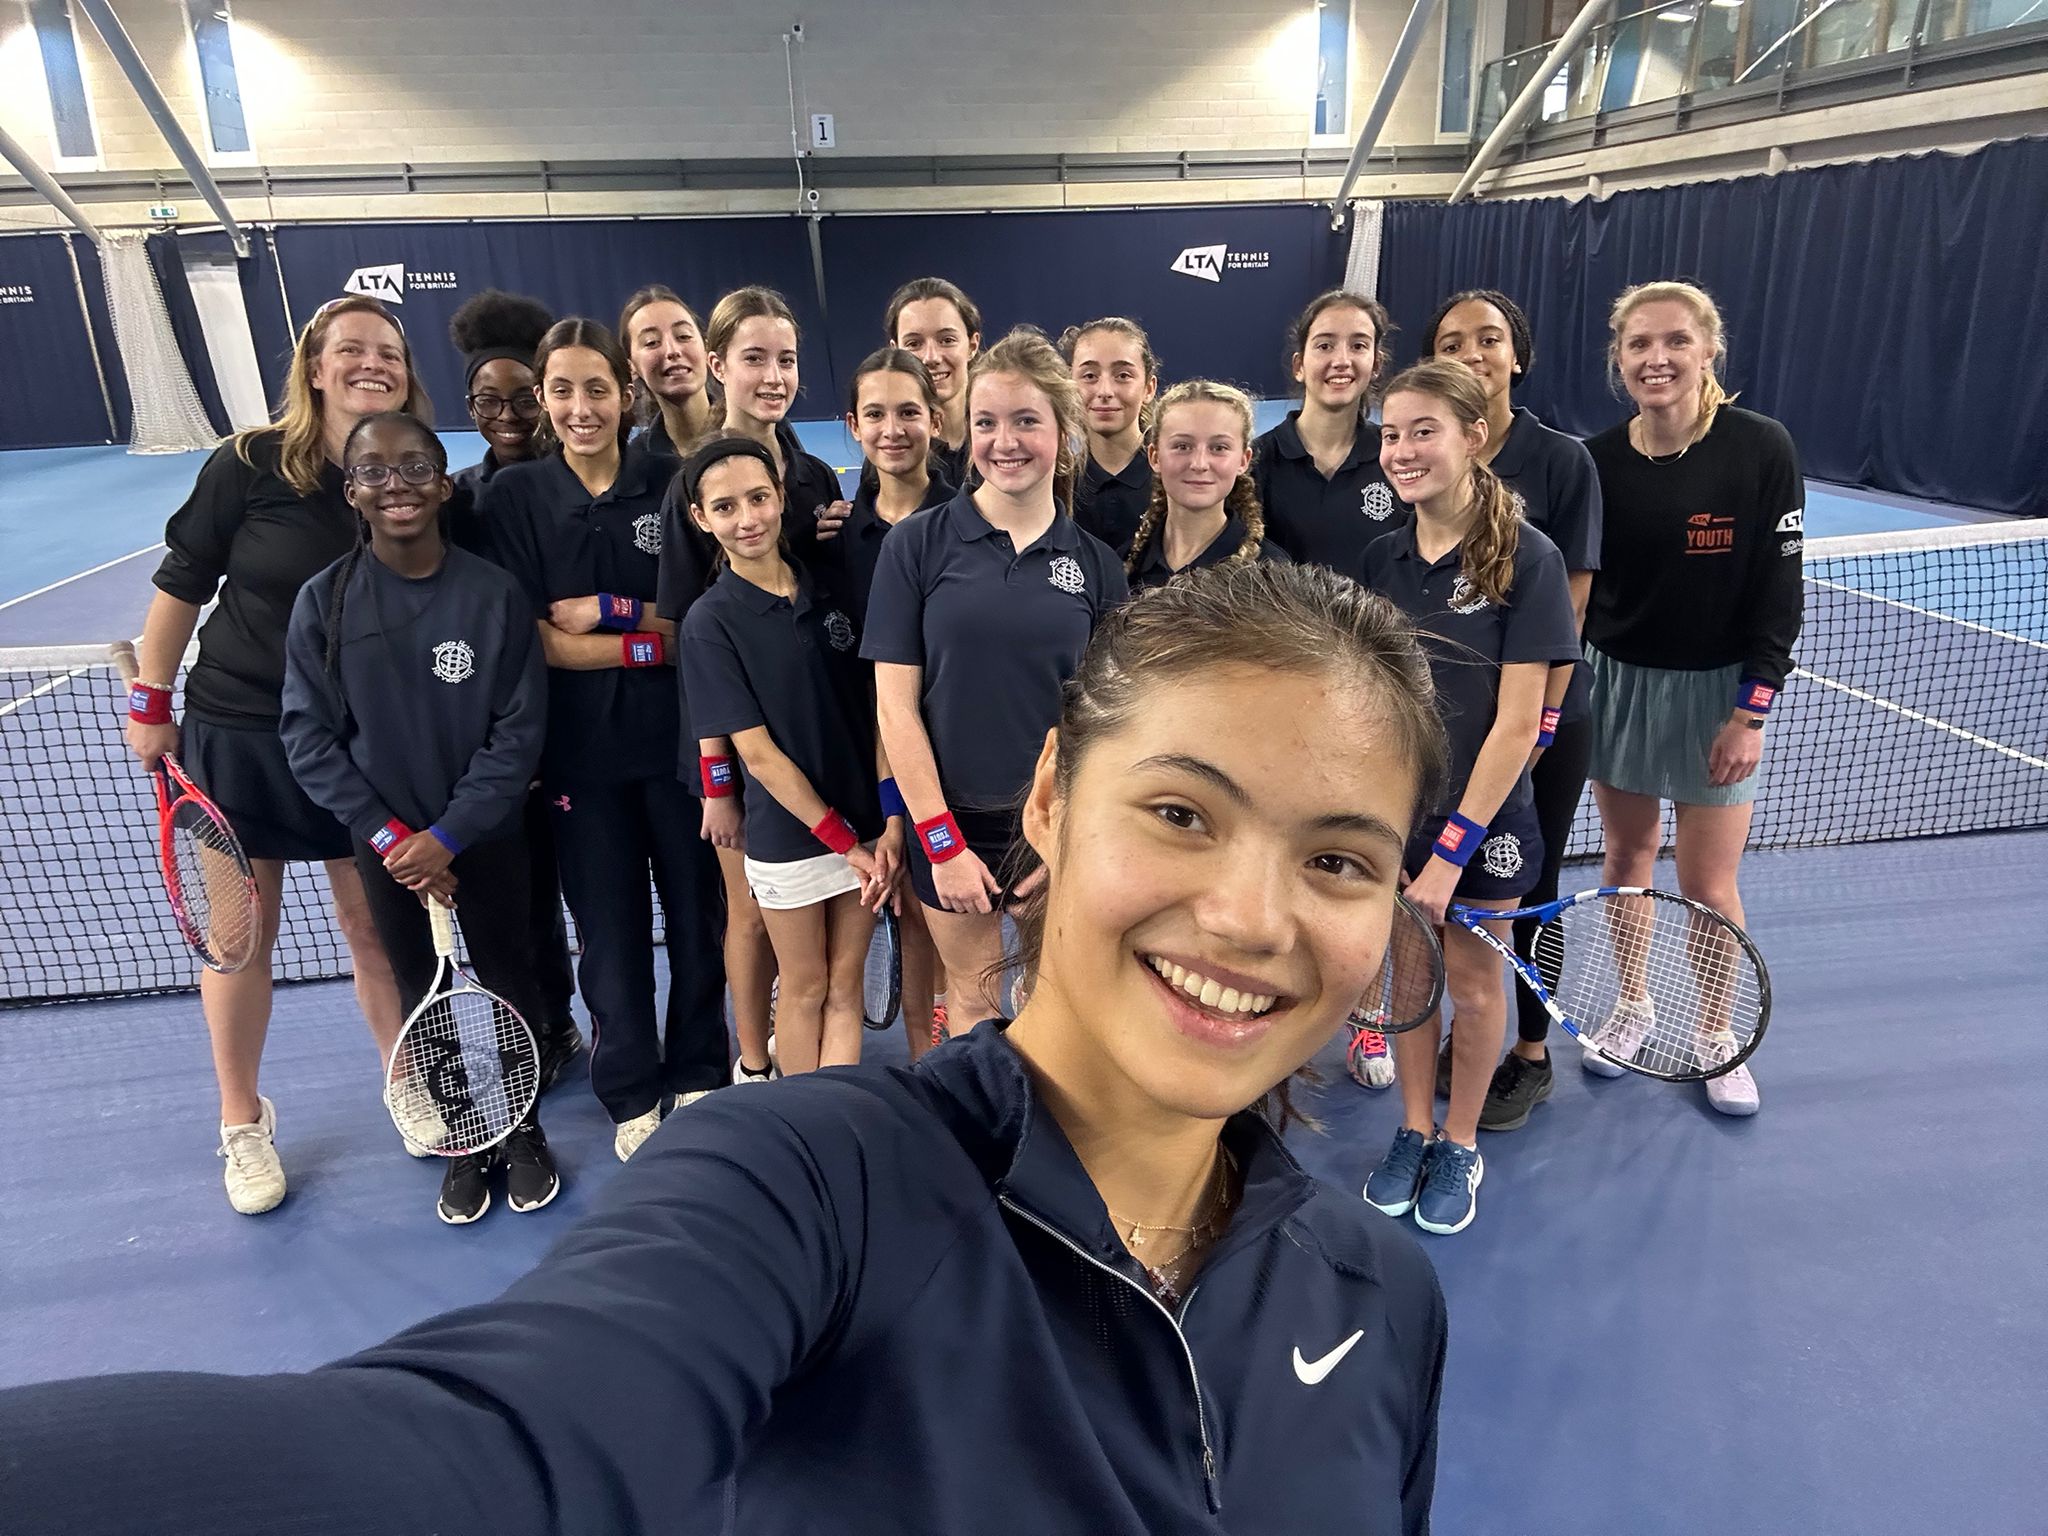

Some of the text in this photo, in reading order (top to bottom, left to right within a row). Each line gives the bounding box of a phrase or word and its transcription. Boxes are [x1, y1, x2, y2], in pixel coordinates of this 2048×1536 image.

[818, 121, 828, 141] 1
[1227, 252, 1270, 262] TENNIS
[1185, 254, 1220, 279] LTA
[1243, 261, 1269, 269] BRITAIN
[406, 272, 456, 283] TENNIS
[358, 275, 403, 297] LTA
[427, 281, 457, 290] BRITAIN
[2, 296, 34, 304] BRITAIN
[1687, 528, 1733, 547] YOUTH
[929, 830, 951, 844] YOUTH
[1471, 925, 1543, 992] Babolat
